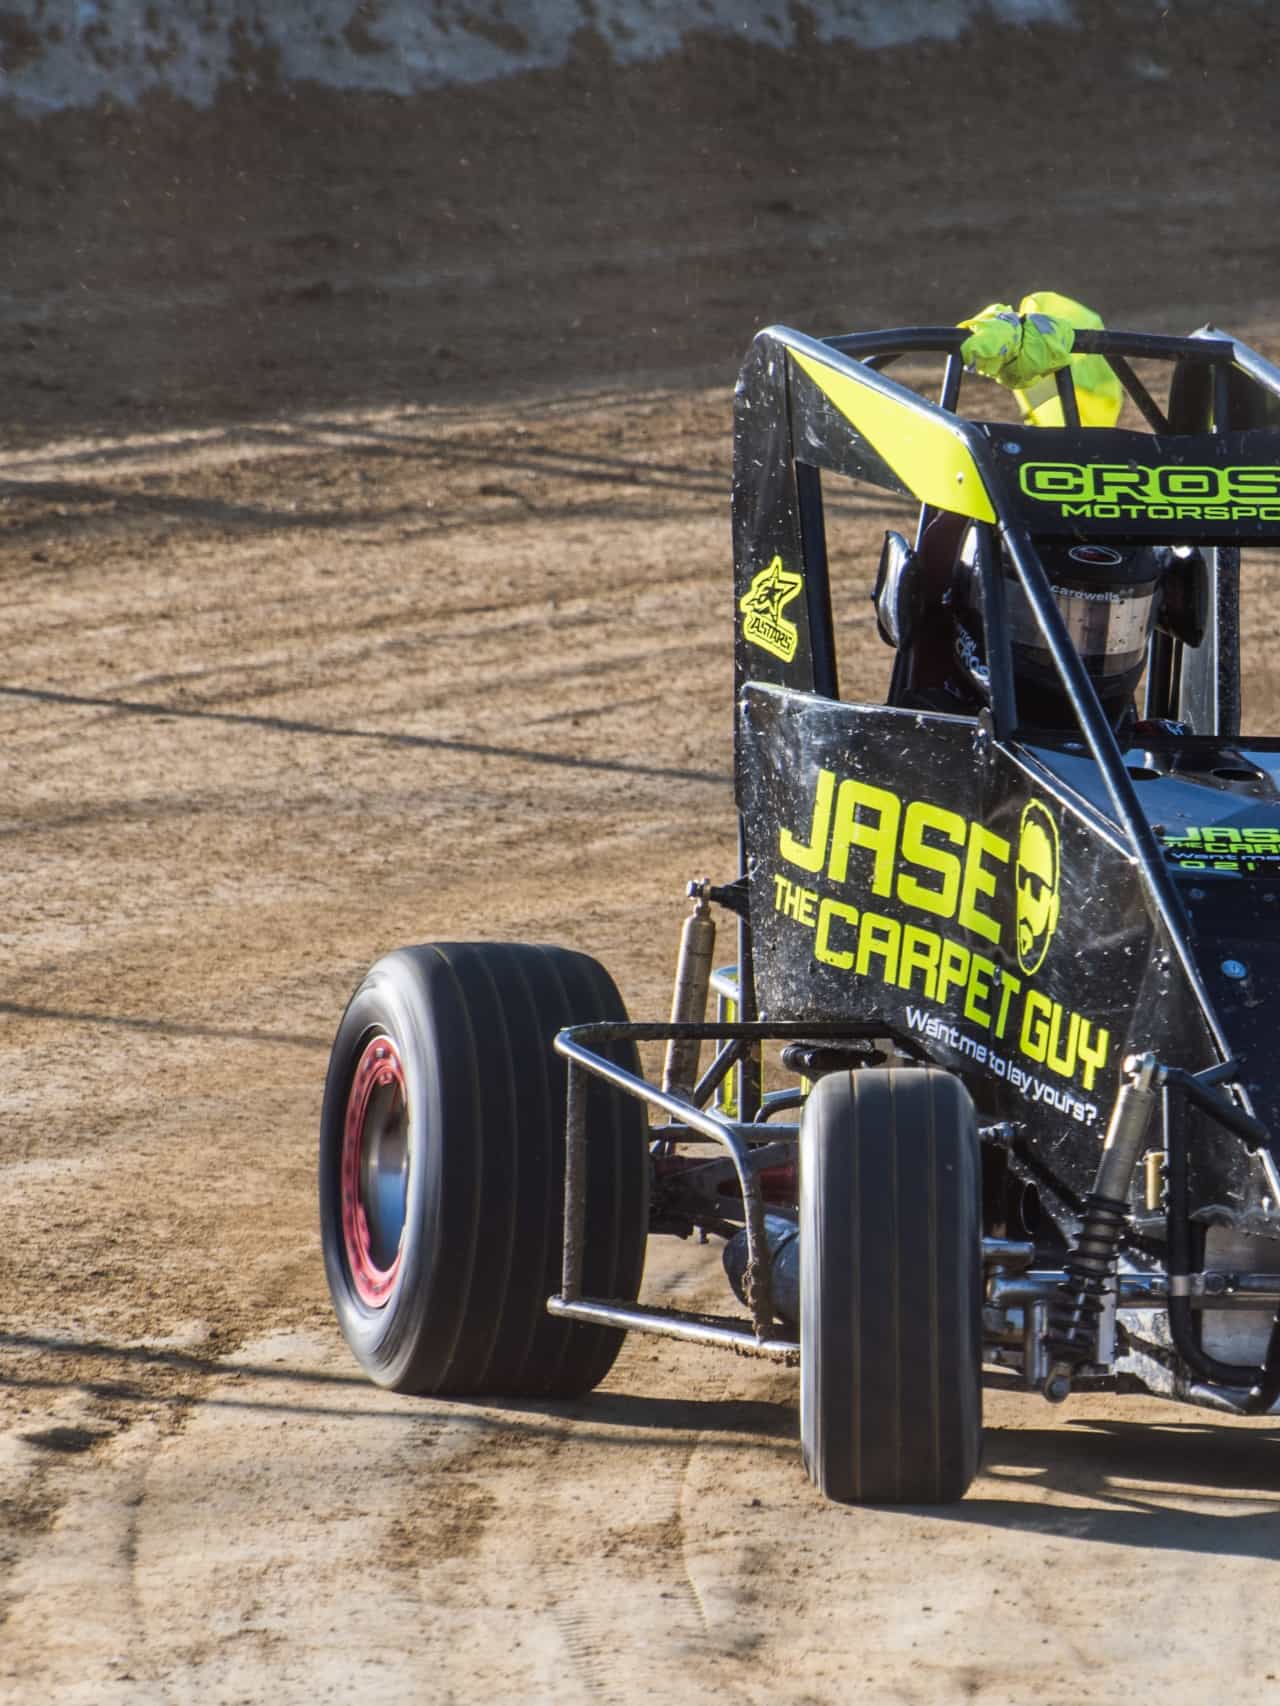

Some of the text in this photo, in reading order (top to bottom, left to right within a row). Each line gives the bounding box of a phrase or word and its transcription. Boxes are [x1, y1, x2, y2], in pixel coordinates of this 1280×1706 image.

[779, 769, 1011, 944] JASE
[1173, 852, 1242, 861] Want
[1180, 861, 1255, 871] 021
[773, 874, 1110, 1092] THE CARPET GUY
[906, 1006, 1098, 1126] Want me to lay yours?
